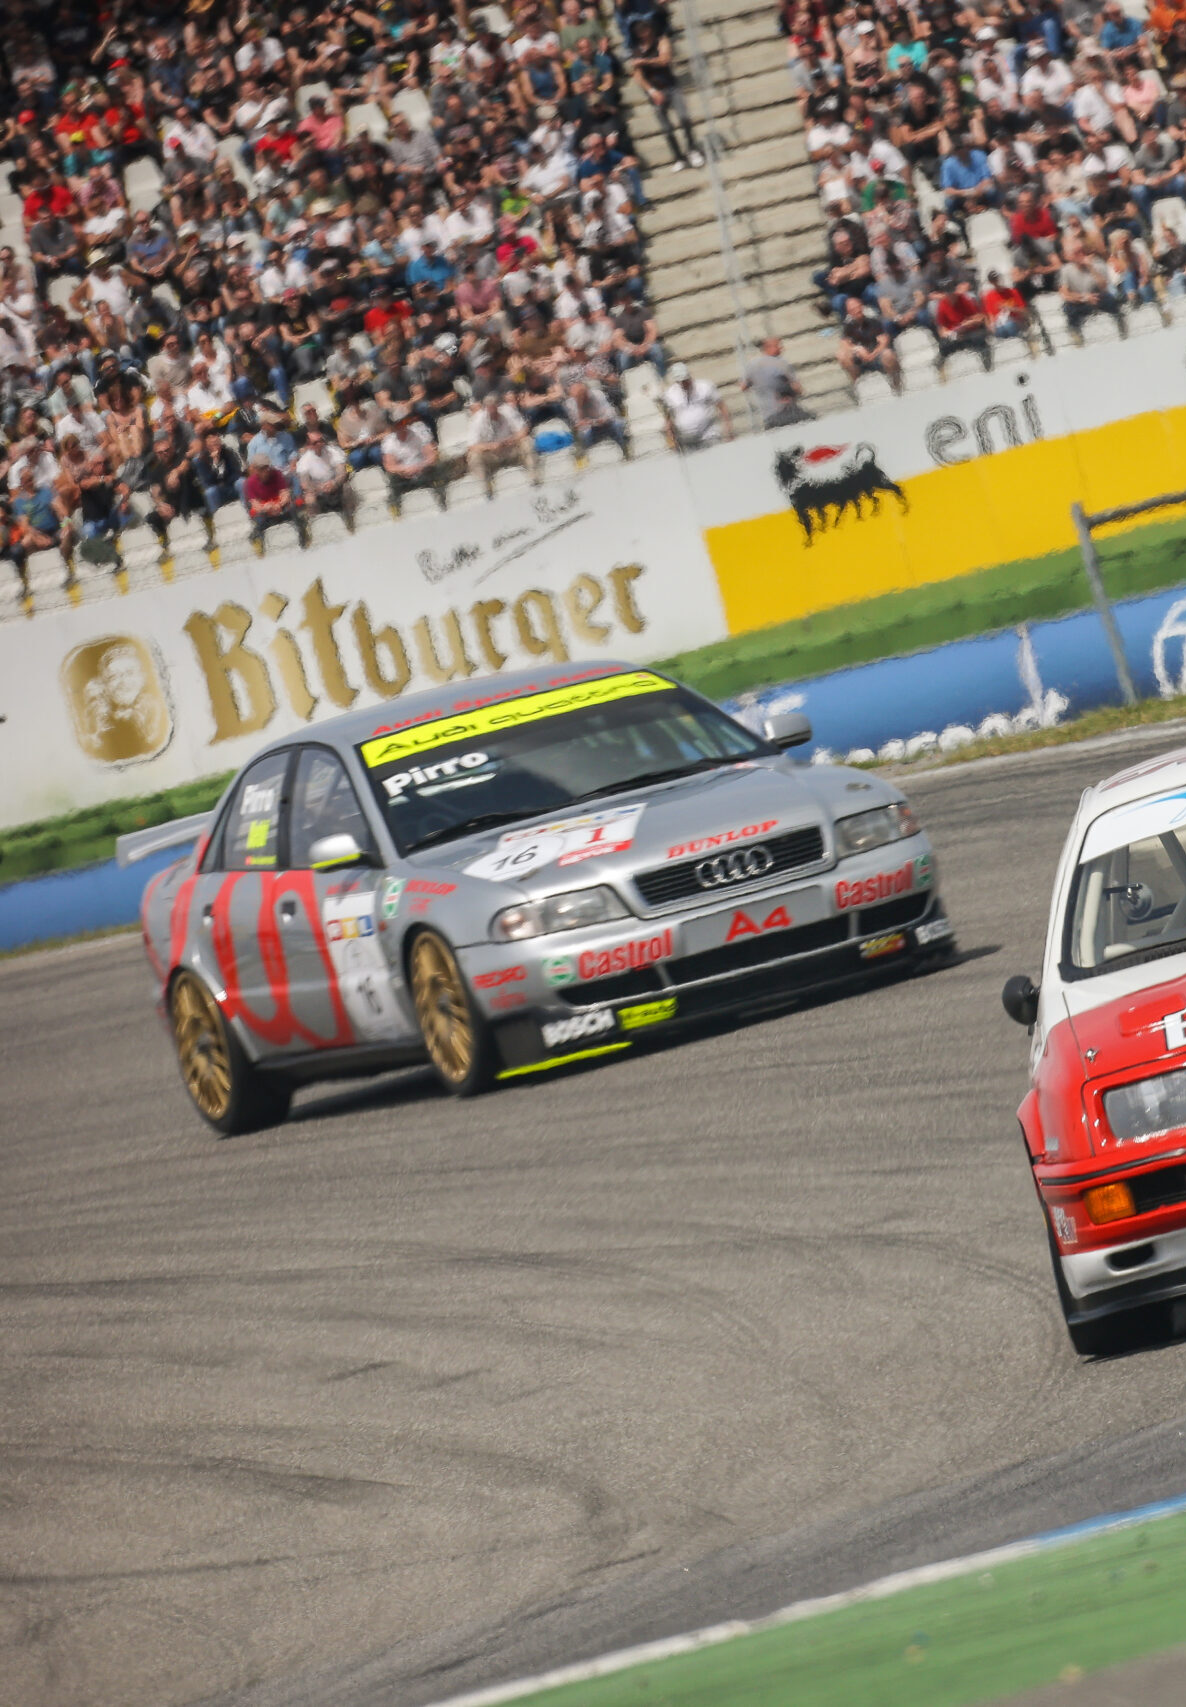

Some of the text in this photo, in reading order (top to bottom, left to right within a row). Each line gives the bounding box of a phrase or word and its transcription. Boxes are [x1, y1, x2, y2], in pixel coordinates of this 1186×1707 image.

[925, 372, 1045, 467] eni
[184, 564, 646, 744] Bitburger
[382, 752, 490, 798] Pirro
[493, 845, 539, 871] 16
[666, 819, 780, 860] DUNLOP
[835, 860, 914, 911] Castrol
[725, 905, 793, 942] A4
[577, 928, 674, 981] Castrol
[541, 1008, 617, 1049] BOSCH
